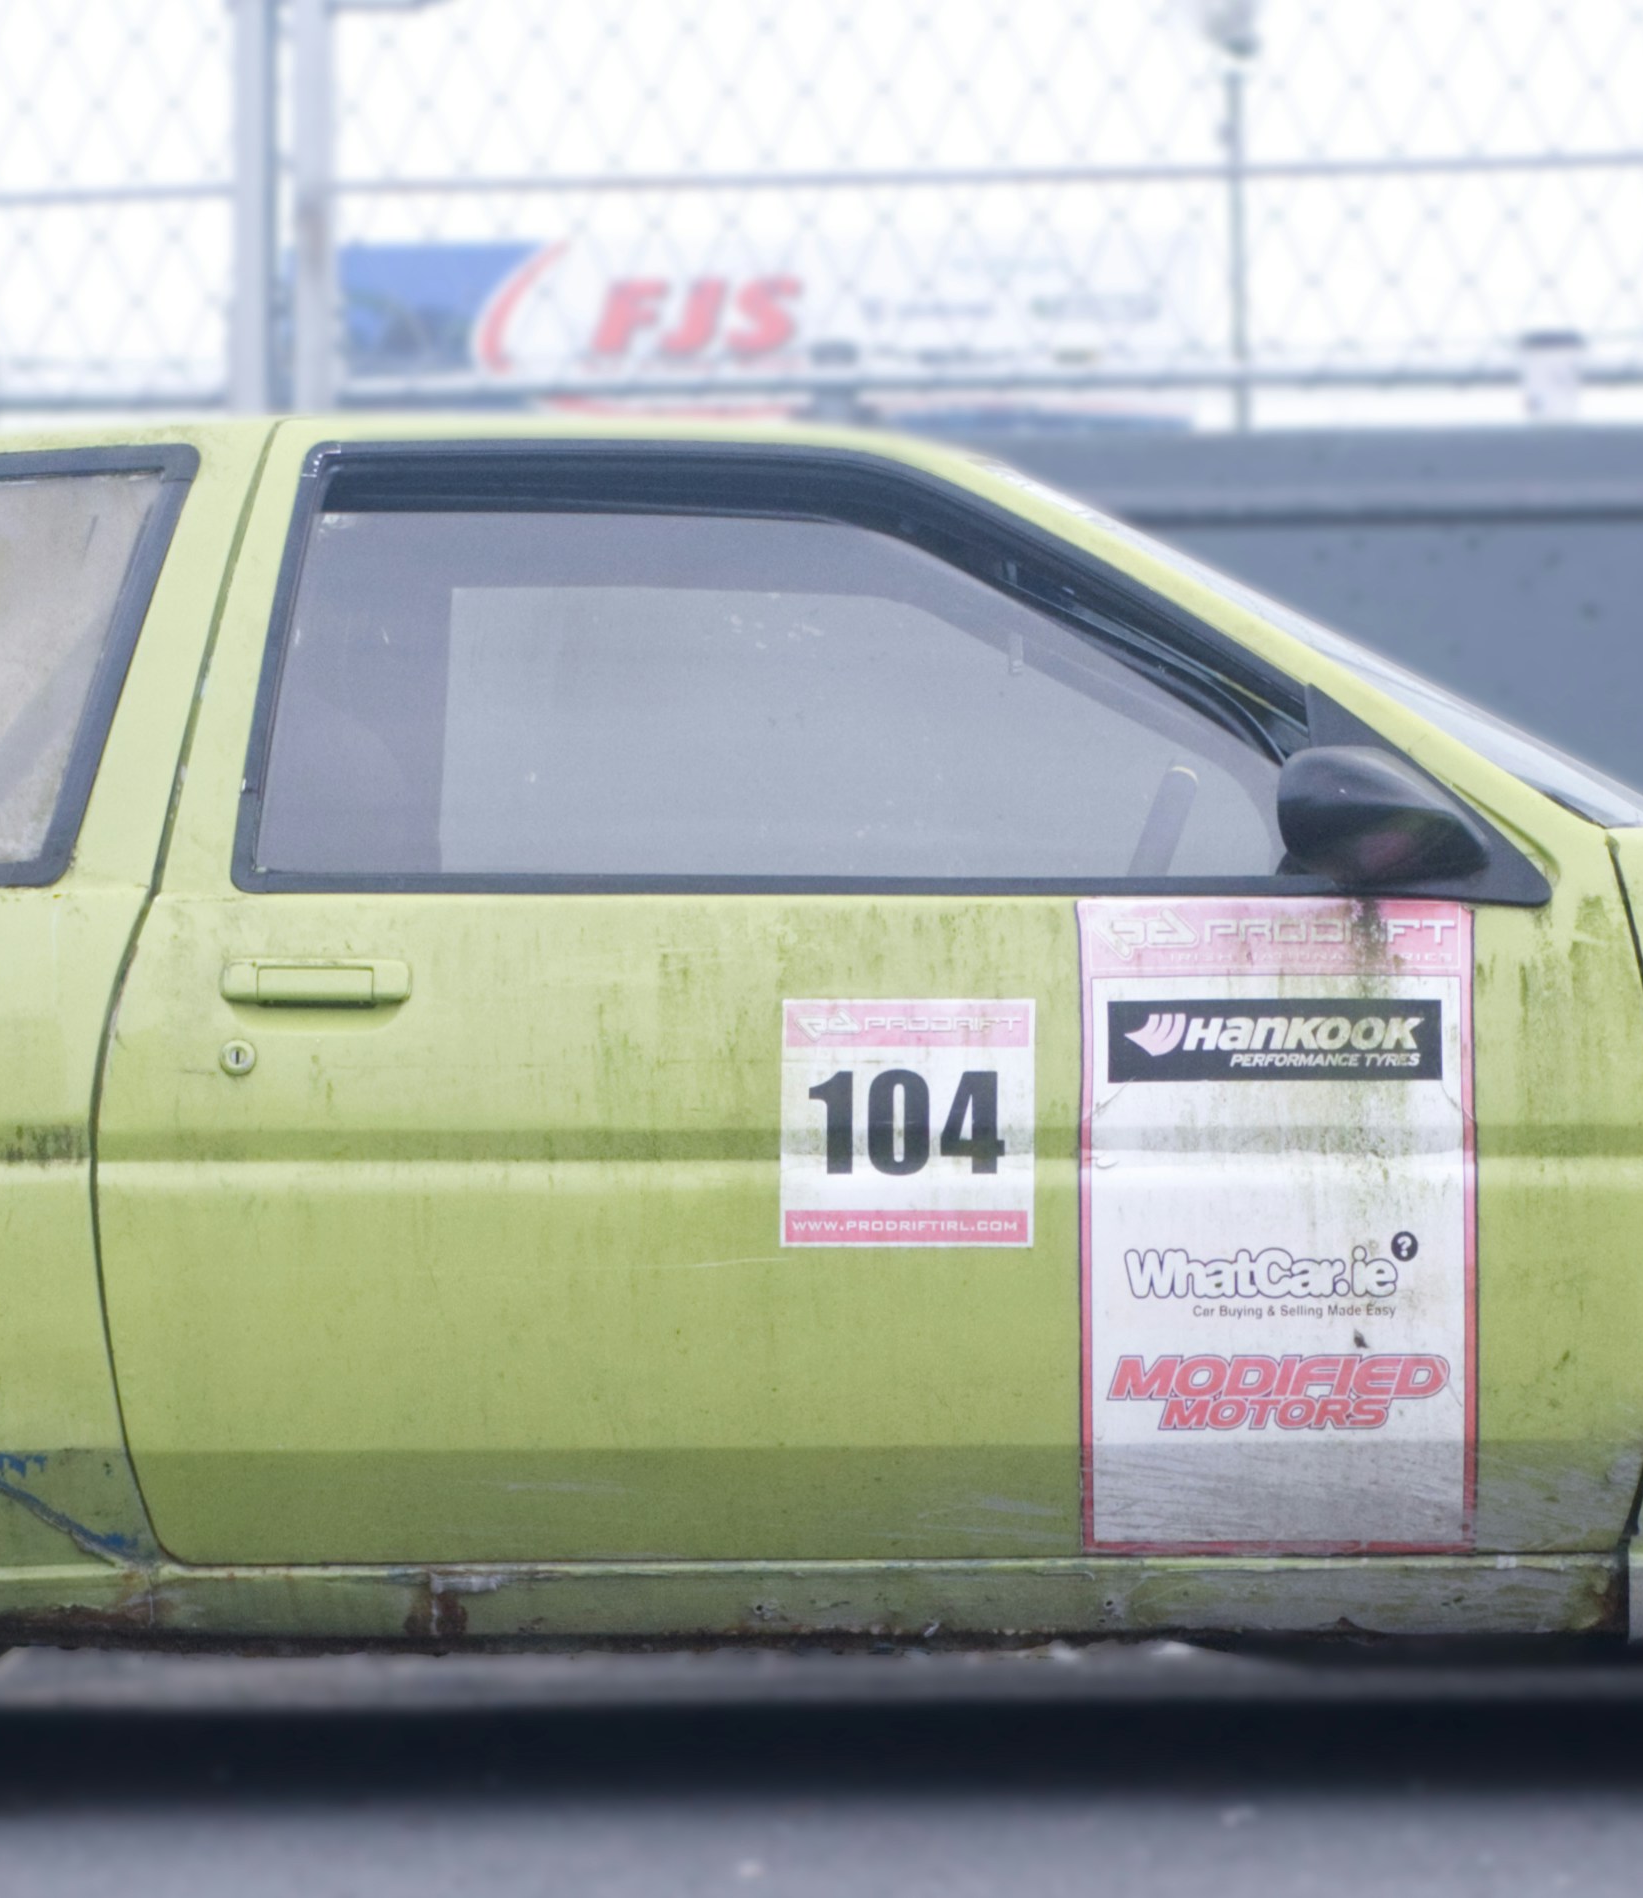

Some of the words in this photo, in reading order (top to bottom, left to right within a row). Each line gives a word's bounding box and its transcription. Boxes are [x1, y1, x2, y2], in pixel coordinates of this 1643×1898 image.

[591, 276, 805, 355] FJS
[864, 1016, 1022, 1032] PRODRIFT
[1229, 1053, 1359, 1067] PERFORMANCE
[1364, 1053, 1421, 1067] TYRES
[808, 1069, 1005, 1176] 104
[792, 1220, 1018, 1232] WWW.PRODRIFTIRL.COM
[1124, 1245, 1399, 1299] WhatCar.ie
[1193, 1304, 1215, 1317] Car
[1219, 1304, 1264, 1319] Buying
[1267, 1305, 1276, 1317] &
[1279, 1304, 1324, 1319] Selling
[1327, 1304, 1362, 1317] Made
[1366, 1303, 1397, 1319] Easy
[1107, 1354, 1451, 1400] MODIFIED
[1158, 1397, 1391, 1430] MOTORS
